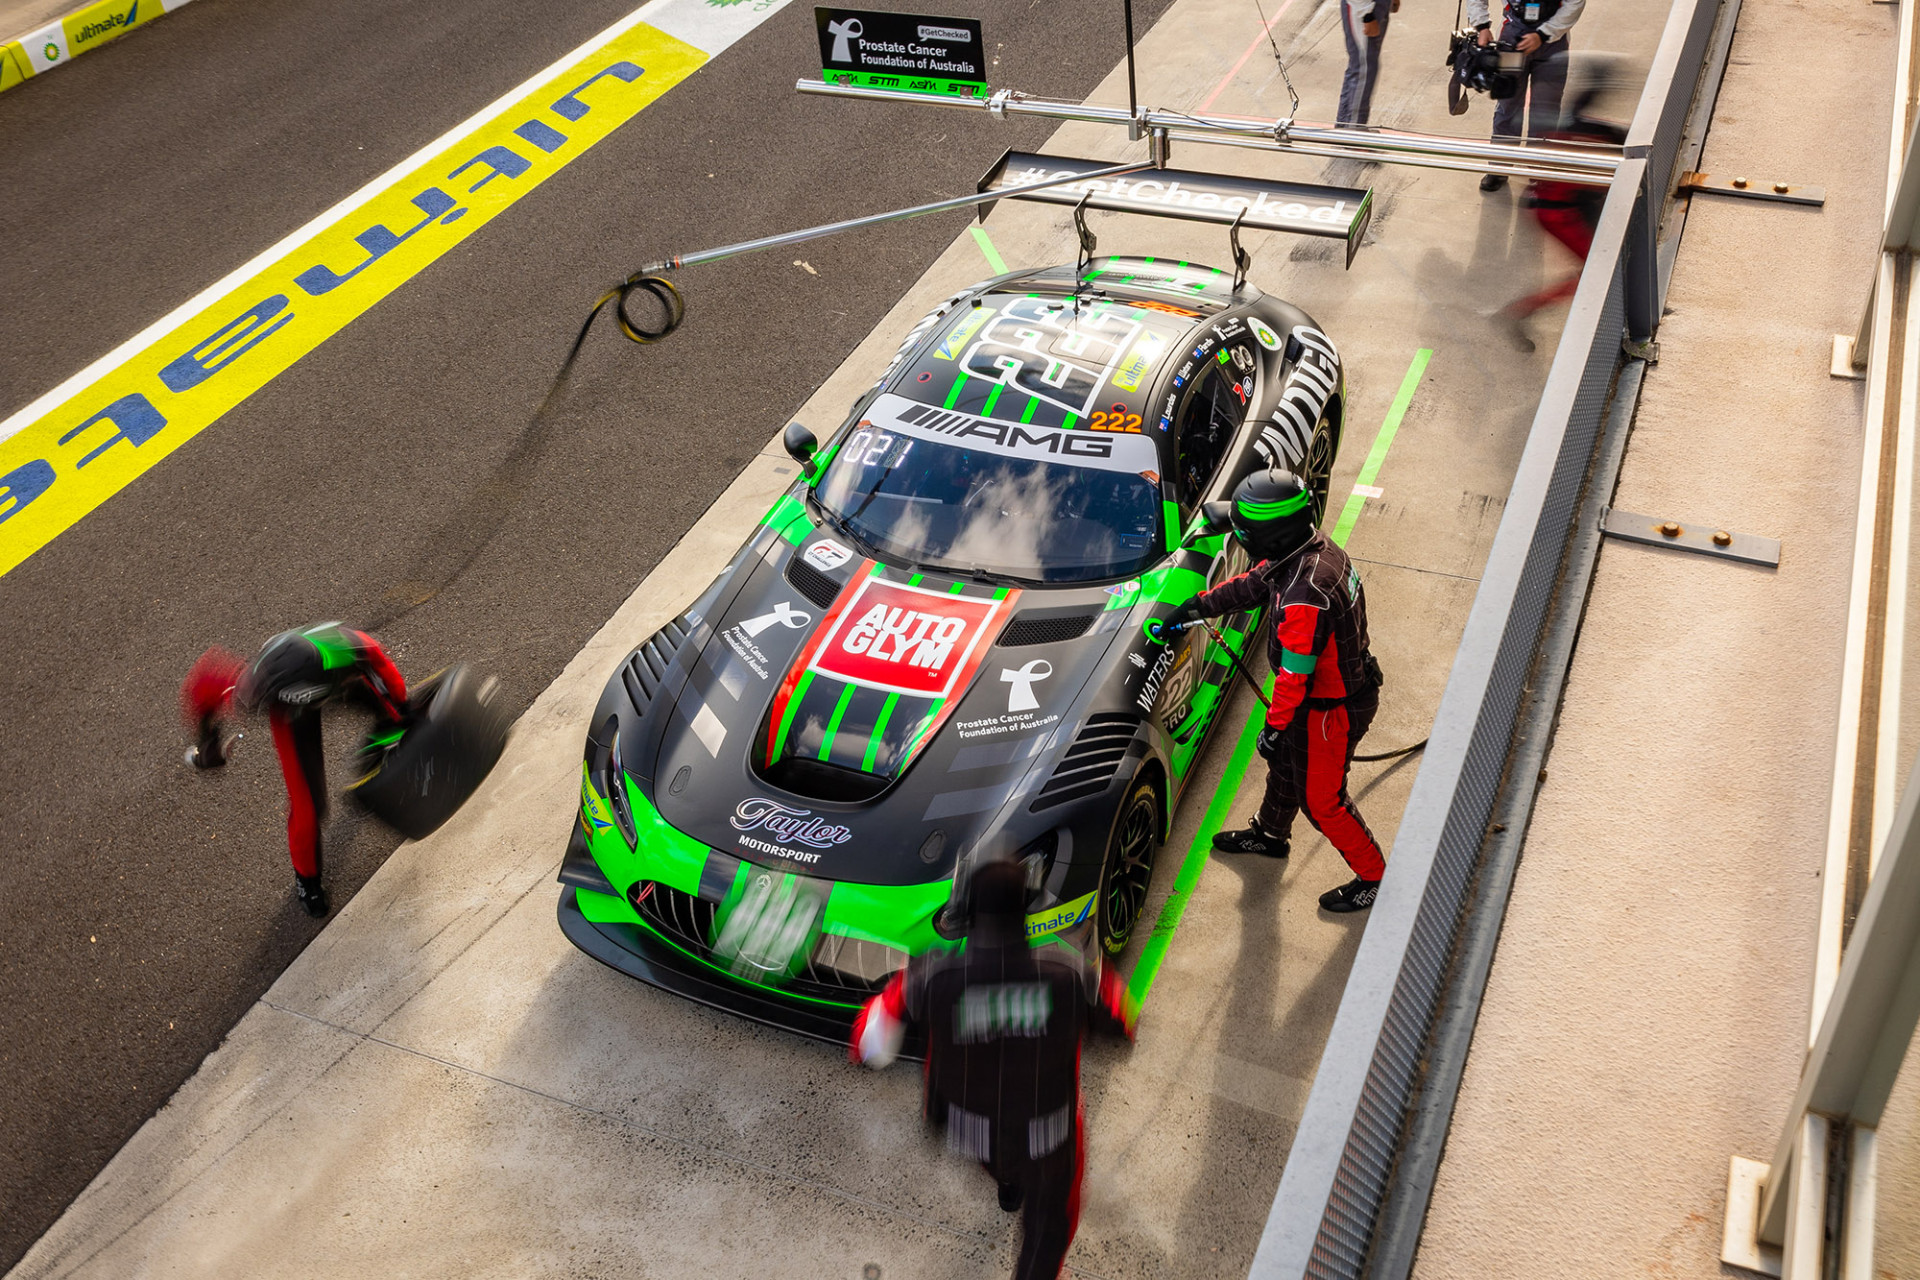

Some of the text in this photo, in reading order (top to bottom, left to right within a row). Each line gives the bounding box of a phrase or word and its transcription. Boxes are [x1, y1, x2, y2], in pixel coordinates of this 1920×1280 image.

[75, 13, 125, 43] ultimate
[920, 28, 969, 39] #GetChecked
[859, 39, 947, 57] Prostate Cancer
[860, 53, 975, 74] Foundation of Australia
[1090, 411, 1143, 433] 222
[843, 431, 914, 468] 021
[855, 603, 967, 644] AUTO
[722, 629, 747, 657] Foundation
[747, 659, 769, 680] Australia
[731, 626, 769, 665] Prostate Cancer
[842, 625, 955, 671] GLYM
[1137, 643, 1175, 713] WATERS
[956, 712, 1035, 730] Prostate Cancer
[959, 714, 1059, 739] Foundation of Australia
[729, 797, 852, 849] Taylor
[738, 834, 822, 864] MOTORSPORT
[1025, 912, 1075, 936] timate
